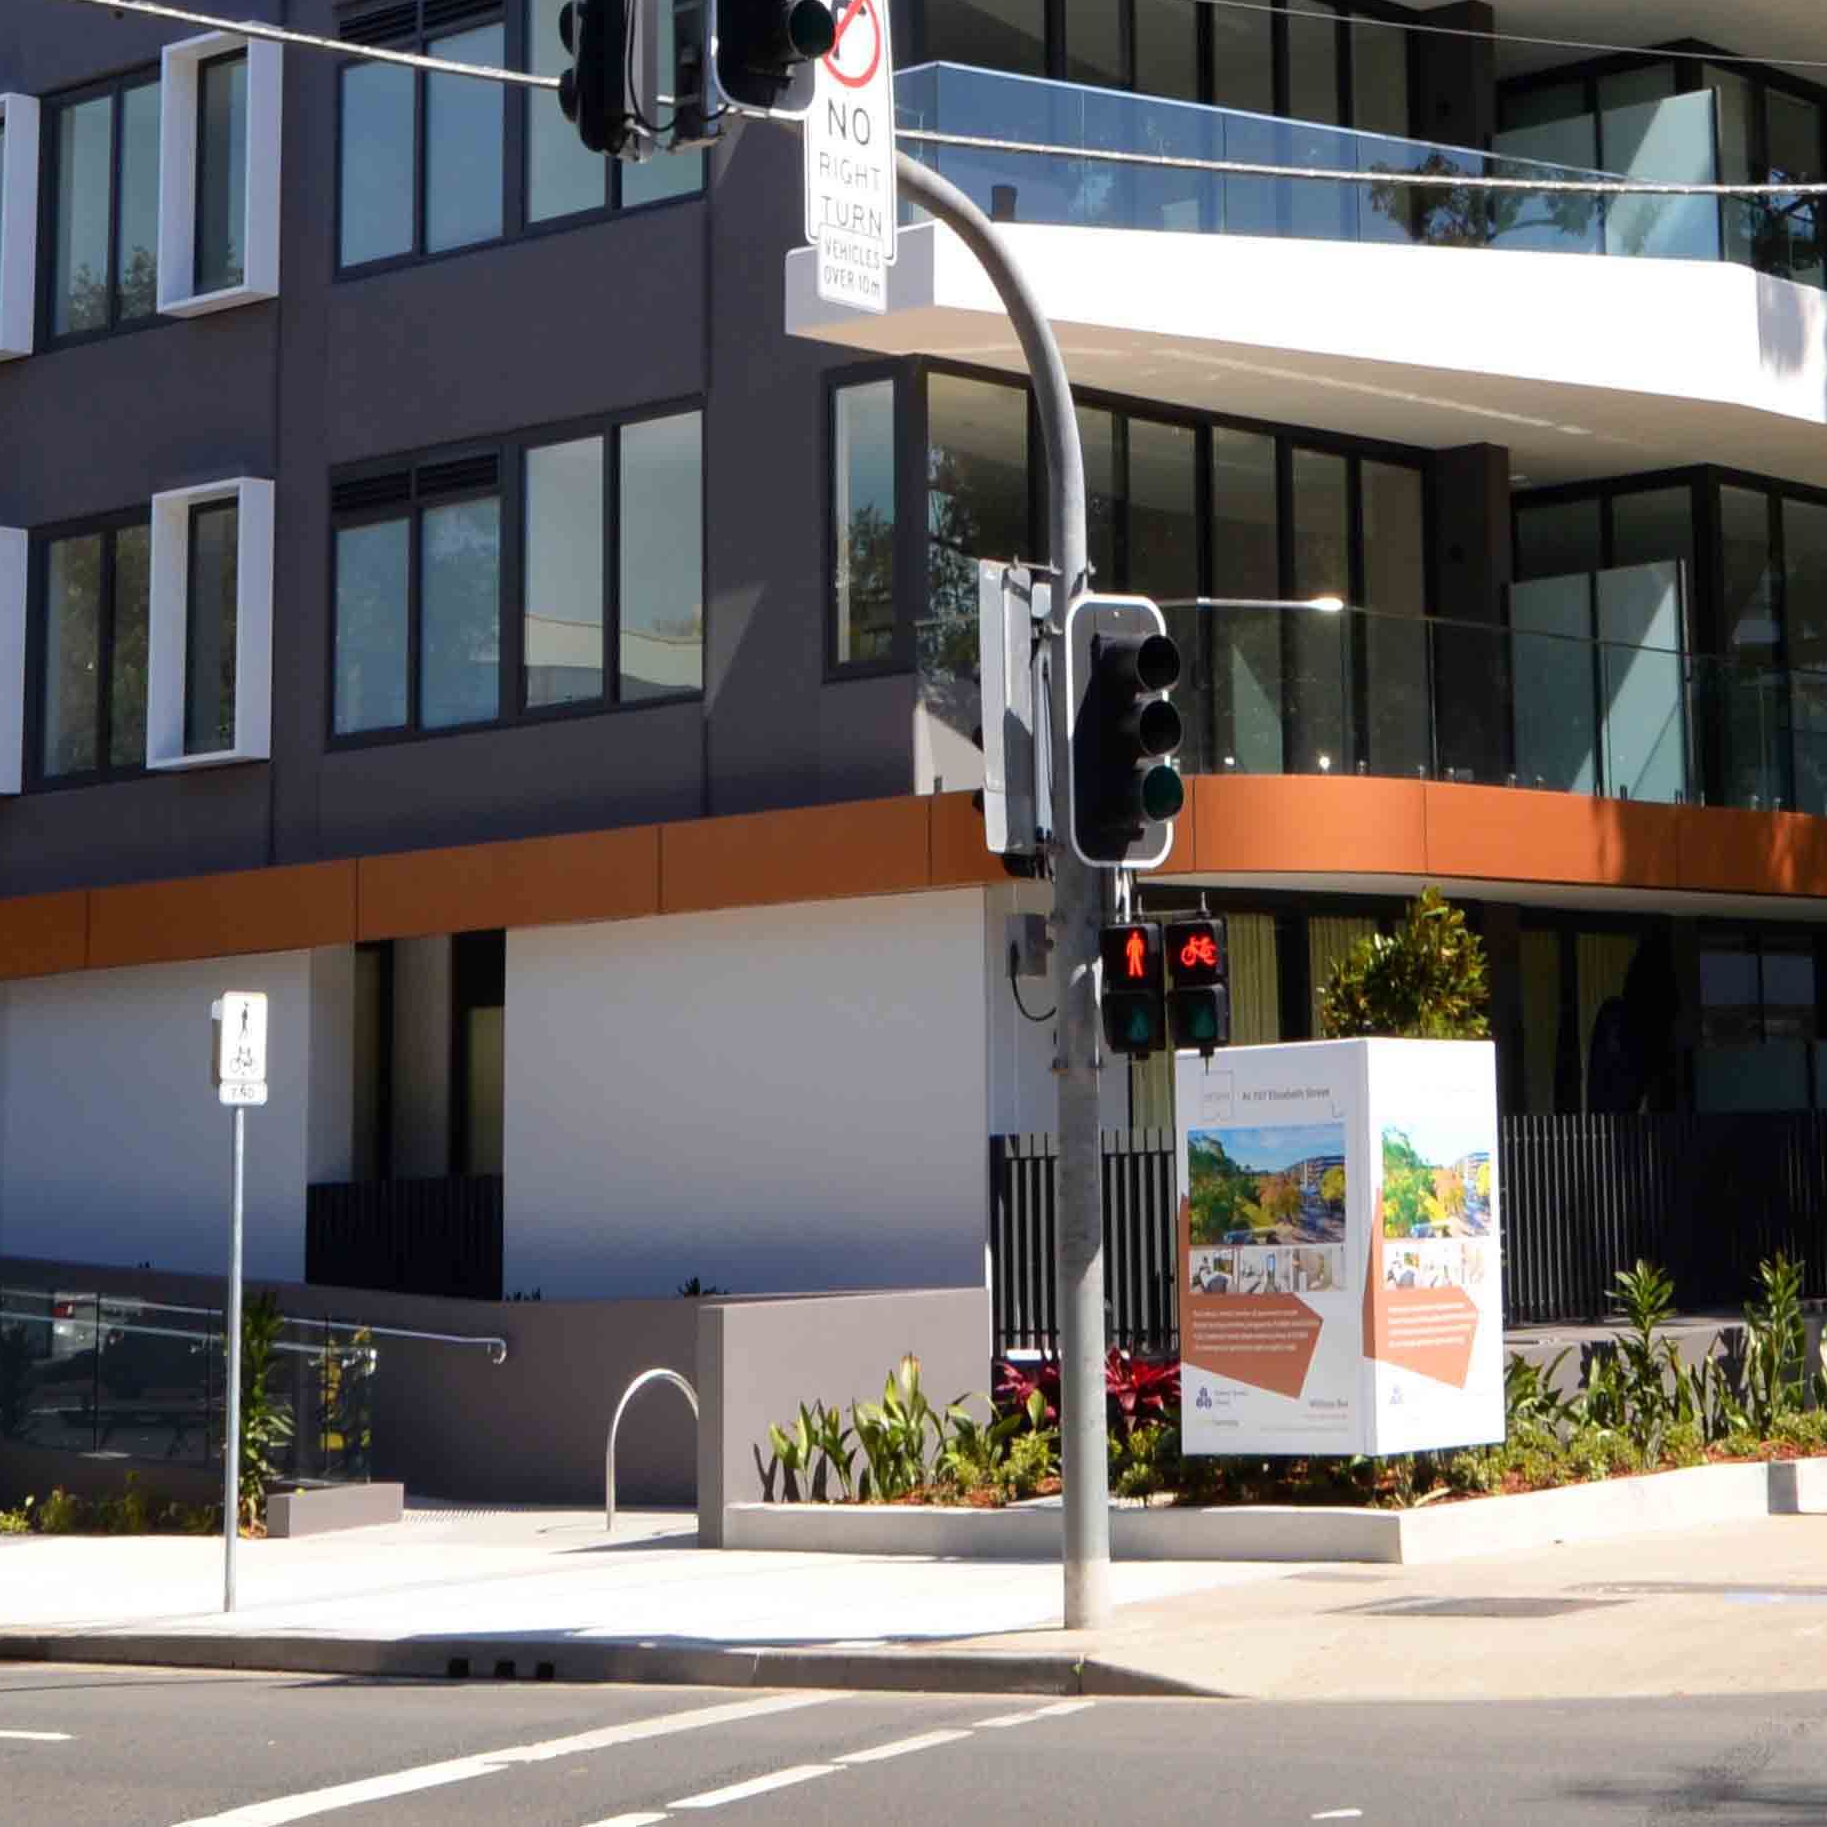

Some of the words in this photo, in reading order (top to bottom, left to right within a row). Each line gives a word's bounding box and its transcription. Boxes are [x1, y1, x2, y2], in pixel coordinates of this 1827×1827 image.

[828, 97, 871, 146] NO
[819, 152, 881, 194] RIGHT
[820, 195, 883, 237] TURN
[824, 236, 881, 271] VEHICLES
[824, 265, 854, 292] OVER
